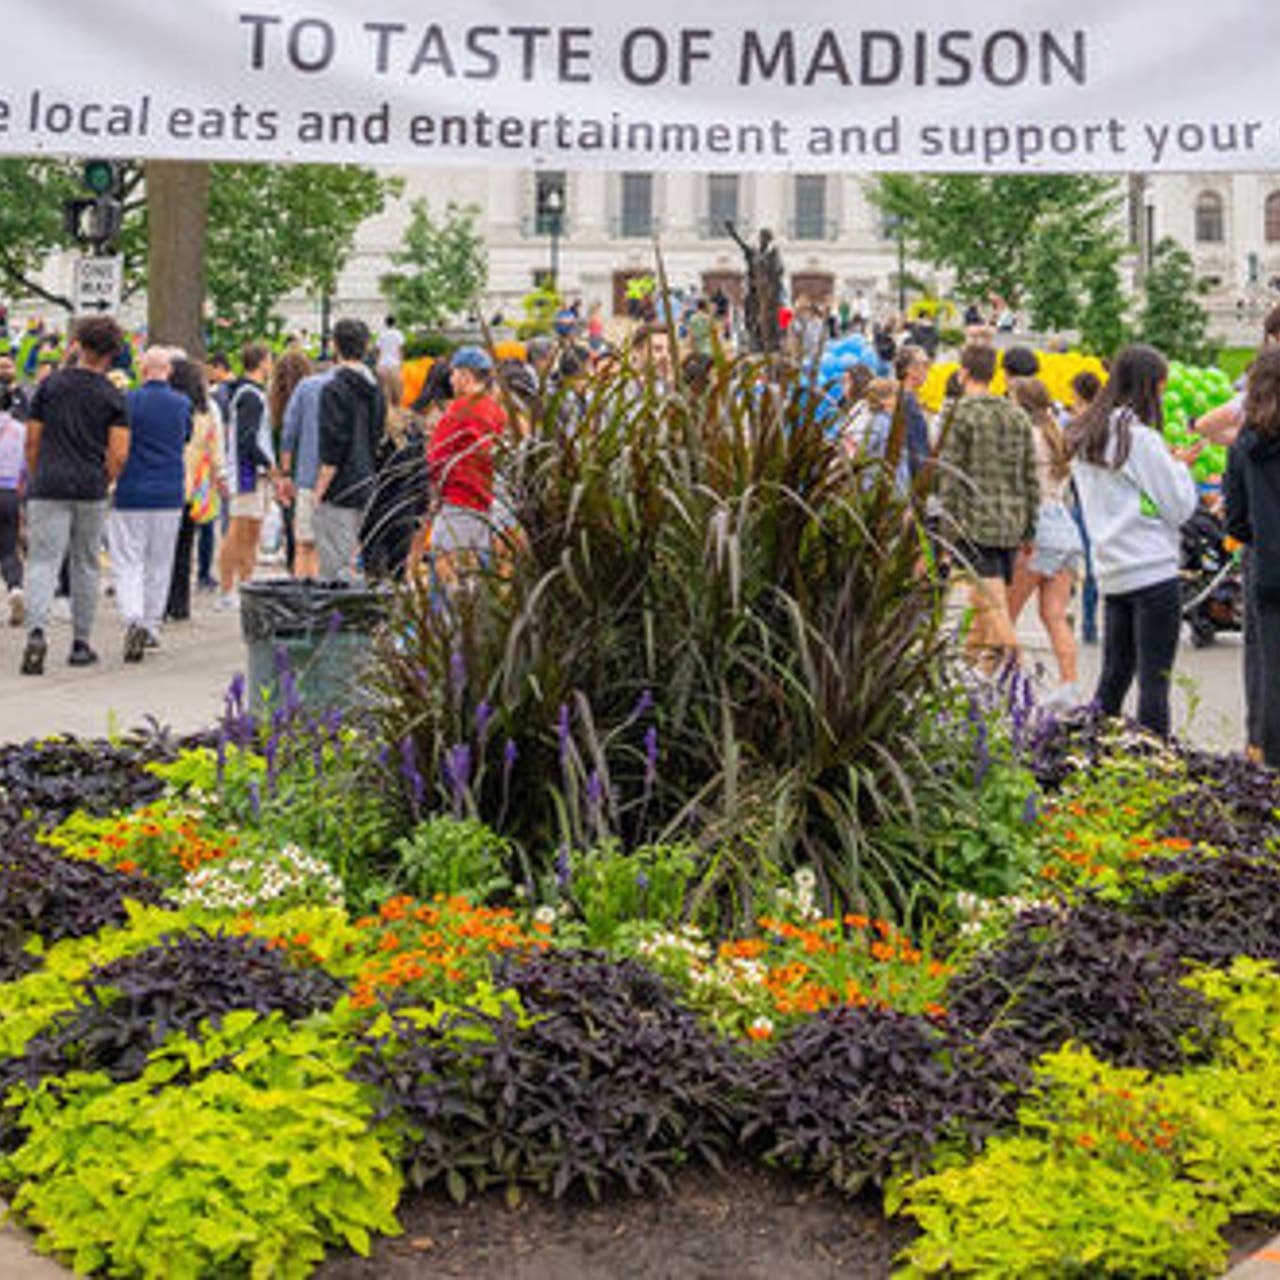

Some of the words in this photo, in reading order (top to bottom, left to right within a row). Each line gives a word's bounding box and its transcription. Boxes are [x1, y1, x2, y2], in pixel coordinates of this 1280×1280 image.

[240, 14, 336, 74] TO
[364, 22, 592, 84] TASTE
[621, 26, 712, 87] OF
[738, 28, 1087, 88] MADISON
[29, 90, 150, 137] local
[168, 105, 278, 142] eats
[297, 103, 390, 146] and
[409, 113, 789, 156] entertainment
[806, 114, 901, 156] and
[920, 116, 1127, 168] support
[1145, 118, 1264, 164] your
